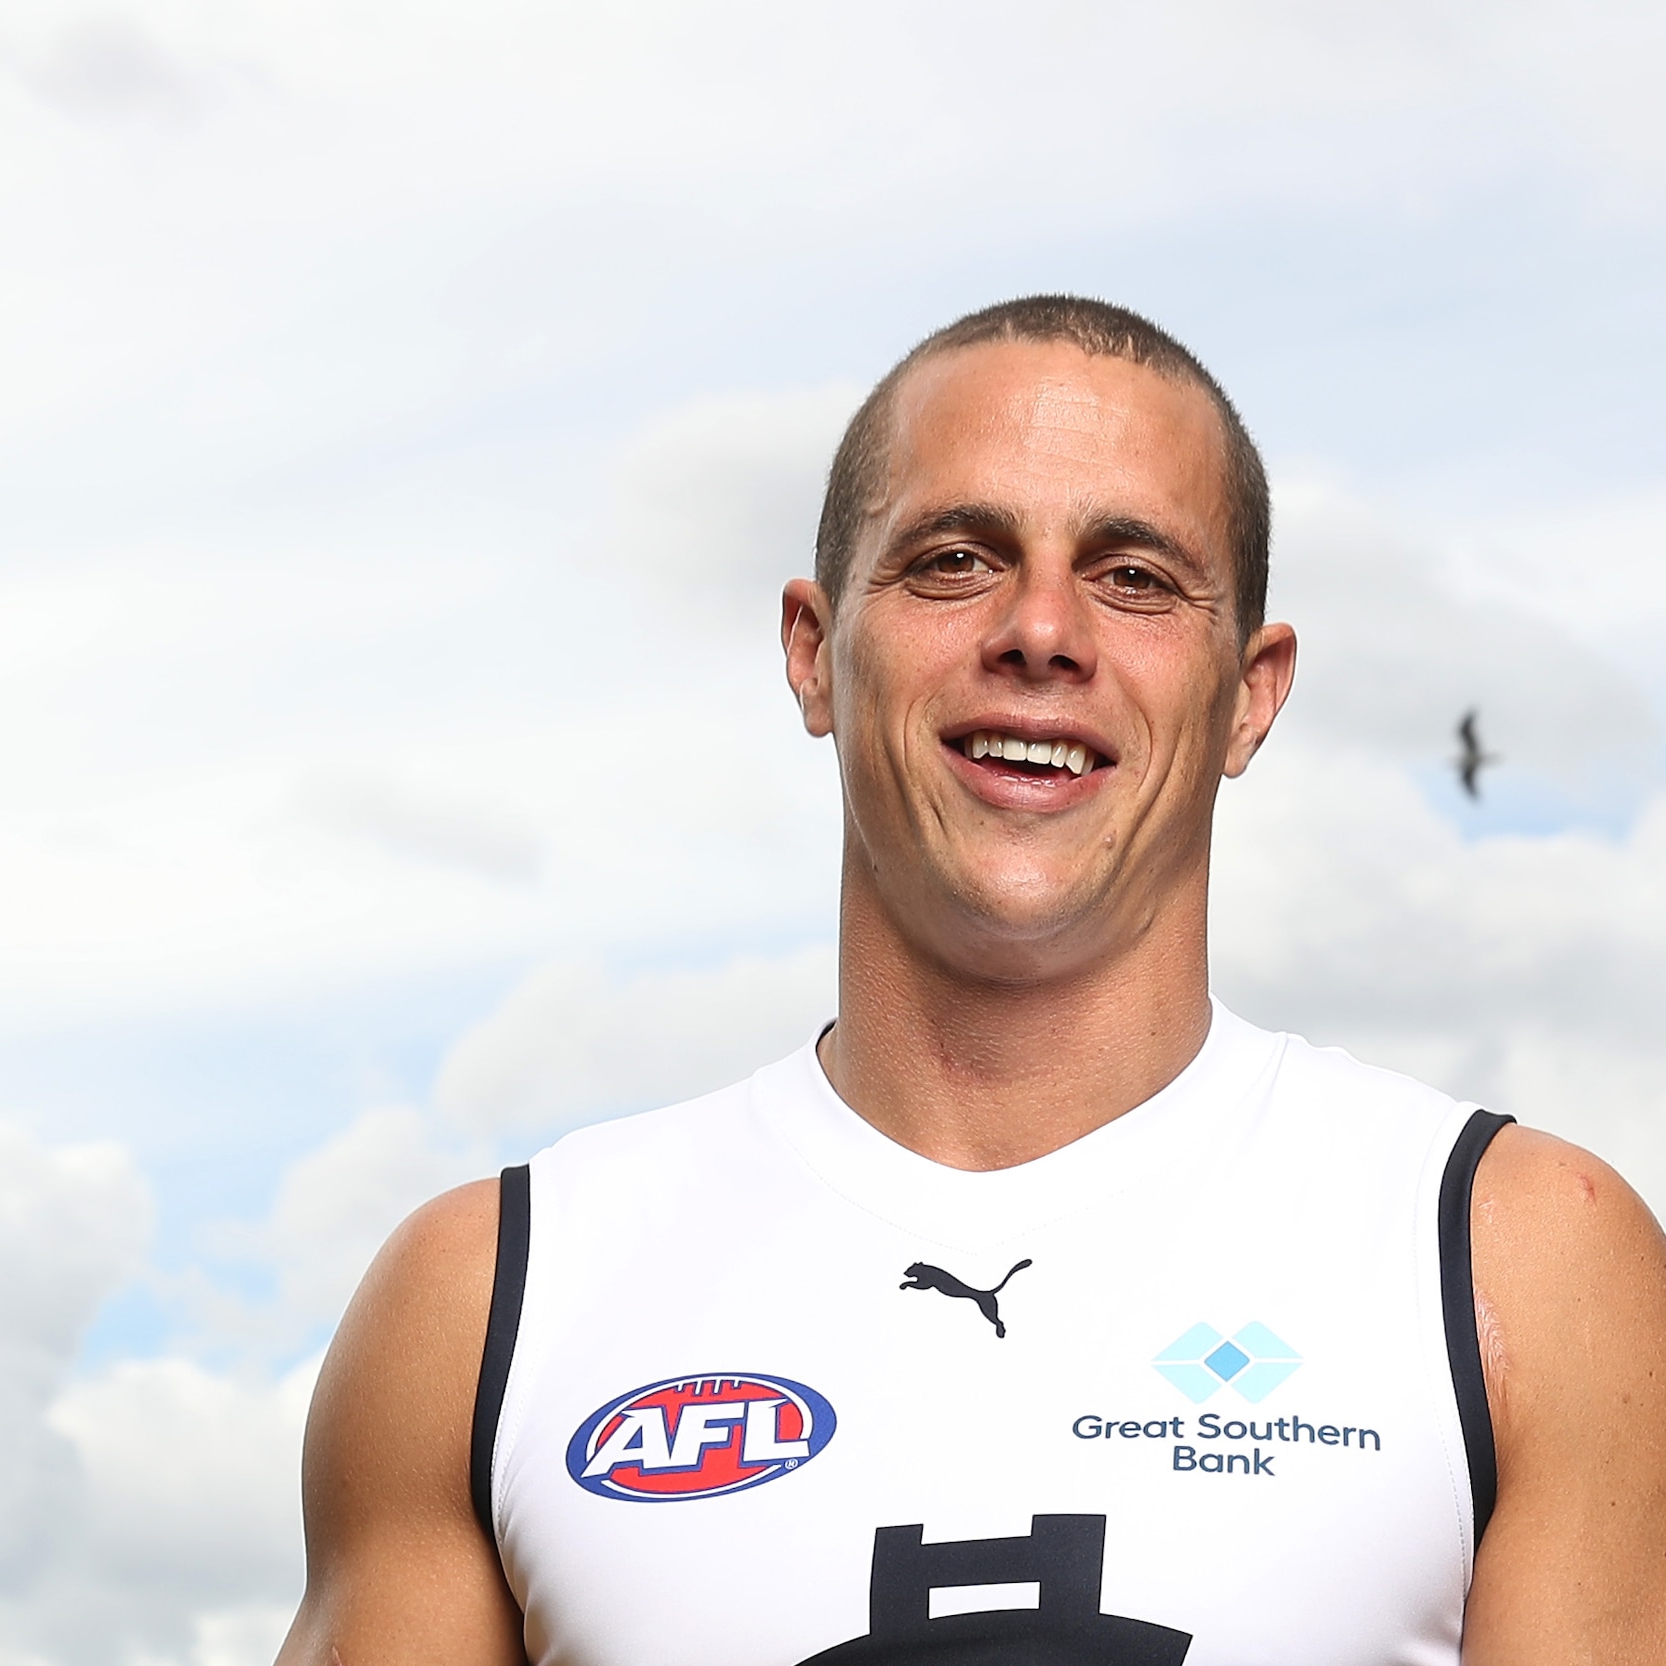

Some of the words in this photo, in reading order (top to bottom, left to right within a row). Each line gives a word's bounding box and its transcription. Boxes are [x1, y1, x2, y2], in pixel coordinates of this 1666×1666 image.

[580, 1398, 810, 1478] AFL
[1072, 1415, 1185, 1440] Great
[1197, 1413, 1381, 1451] Southern
[1172, 1445, 1276, 1476] Bank
